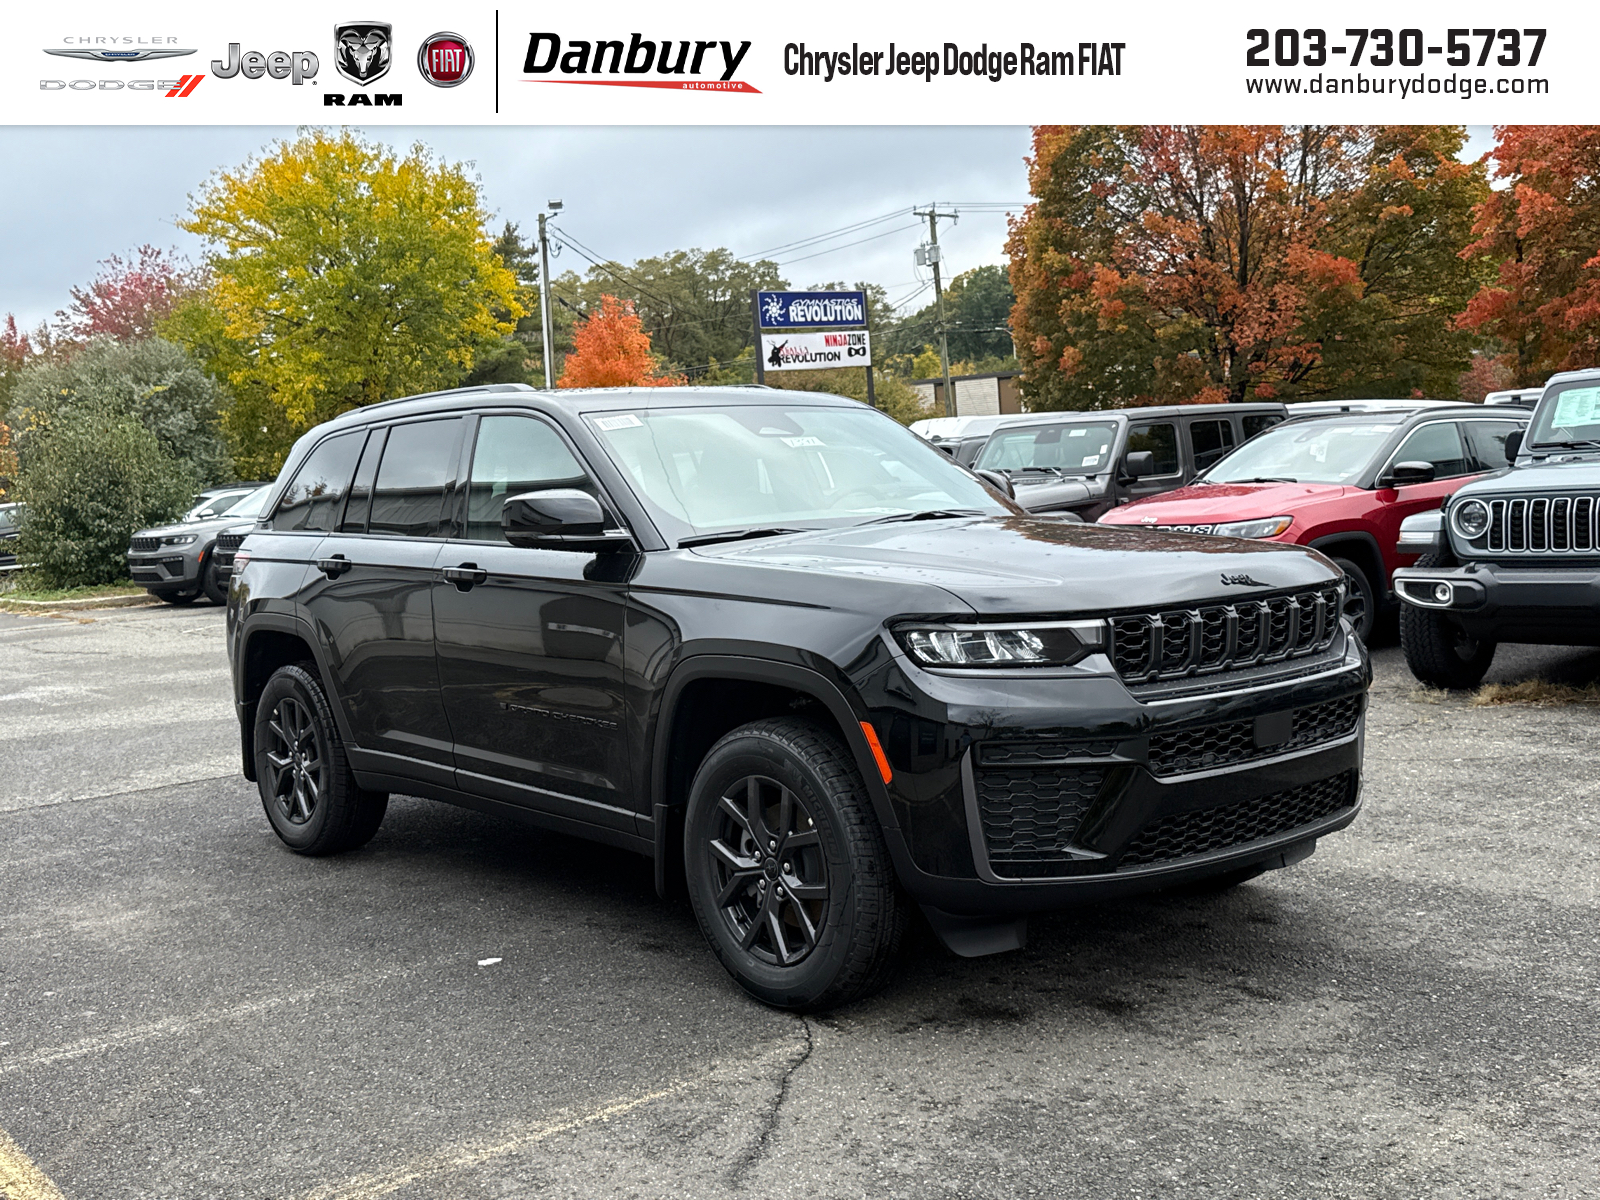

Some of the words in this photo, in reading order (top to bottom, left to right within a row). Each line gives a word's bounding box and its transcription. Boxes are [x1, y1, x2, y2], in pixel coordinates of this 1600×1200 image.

[791, 298, 858, 307] GYMNASTICS
[789, 304, 863, 322] REVOLUTION
[780, 351, 841, 364] REVOLUTION
